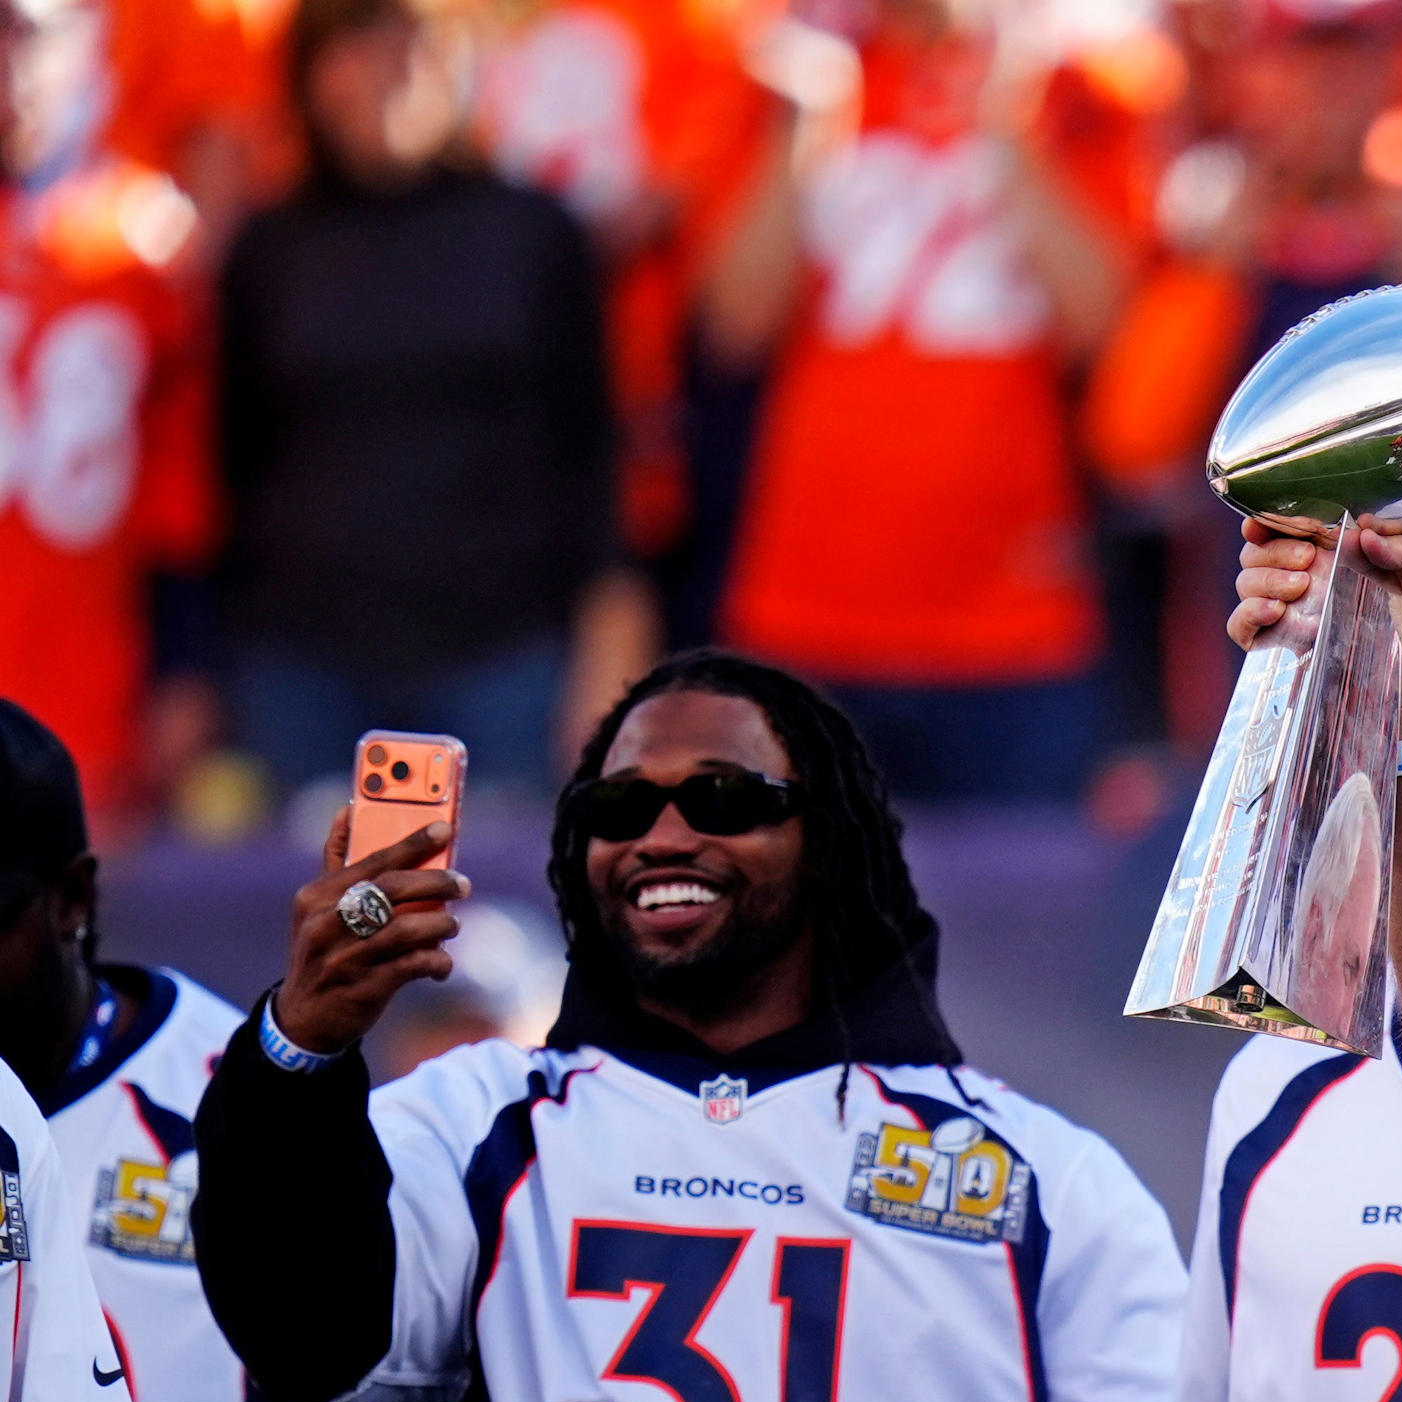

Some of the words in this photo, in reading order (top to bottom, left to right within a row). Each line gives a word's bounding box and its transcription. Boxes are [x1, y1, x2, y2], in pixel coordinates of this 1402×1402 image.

[872, 1123, 1013, 1217] 50
[635, 1175, 806, 1205] BRONCOS
[868, 1198, 939, 1225] SUPER
[940, 1212, 998, 1236] BOWL
